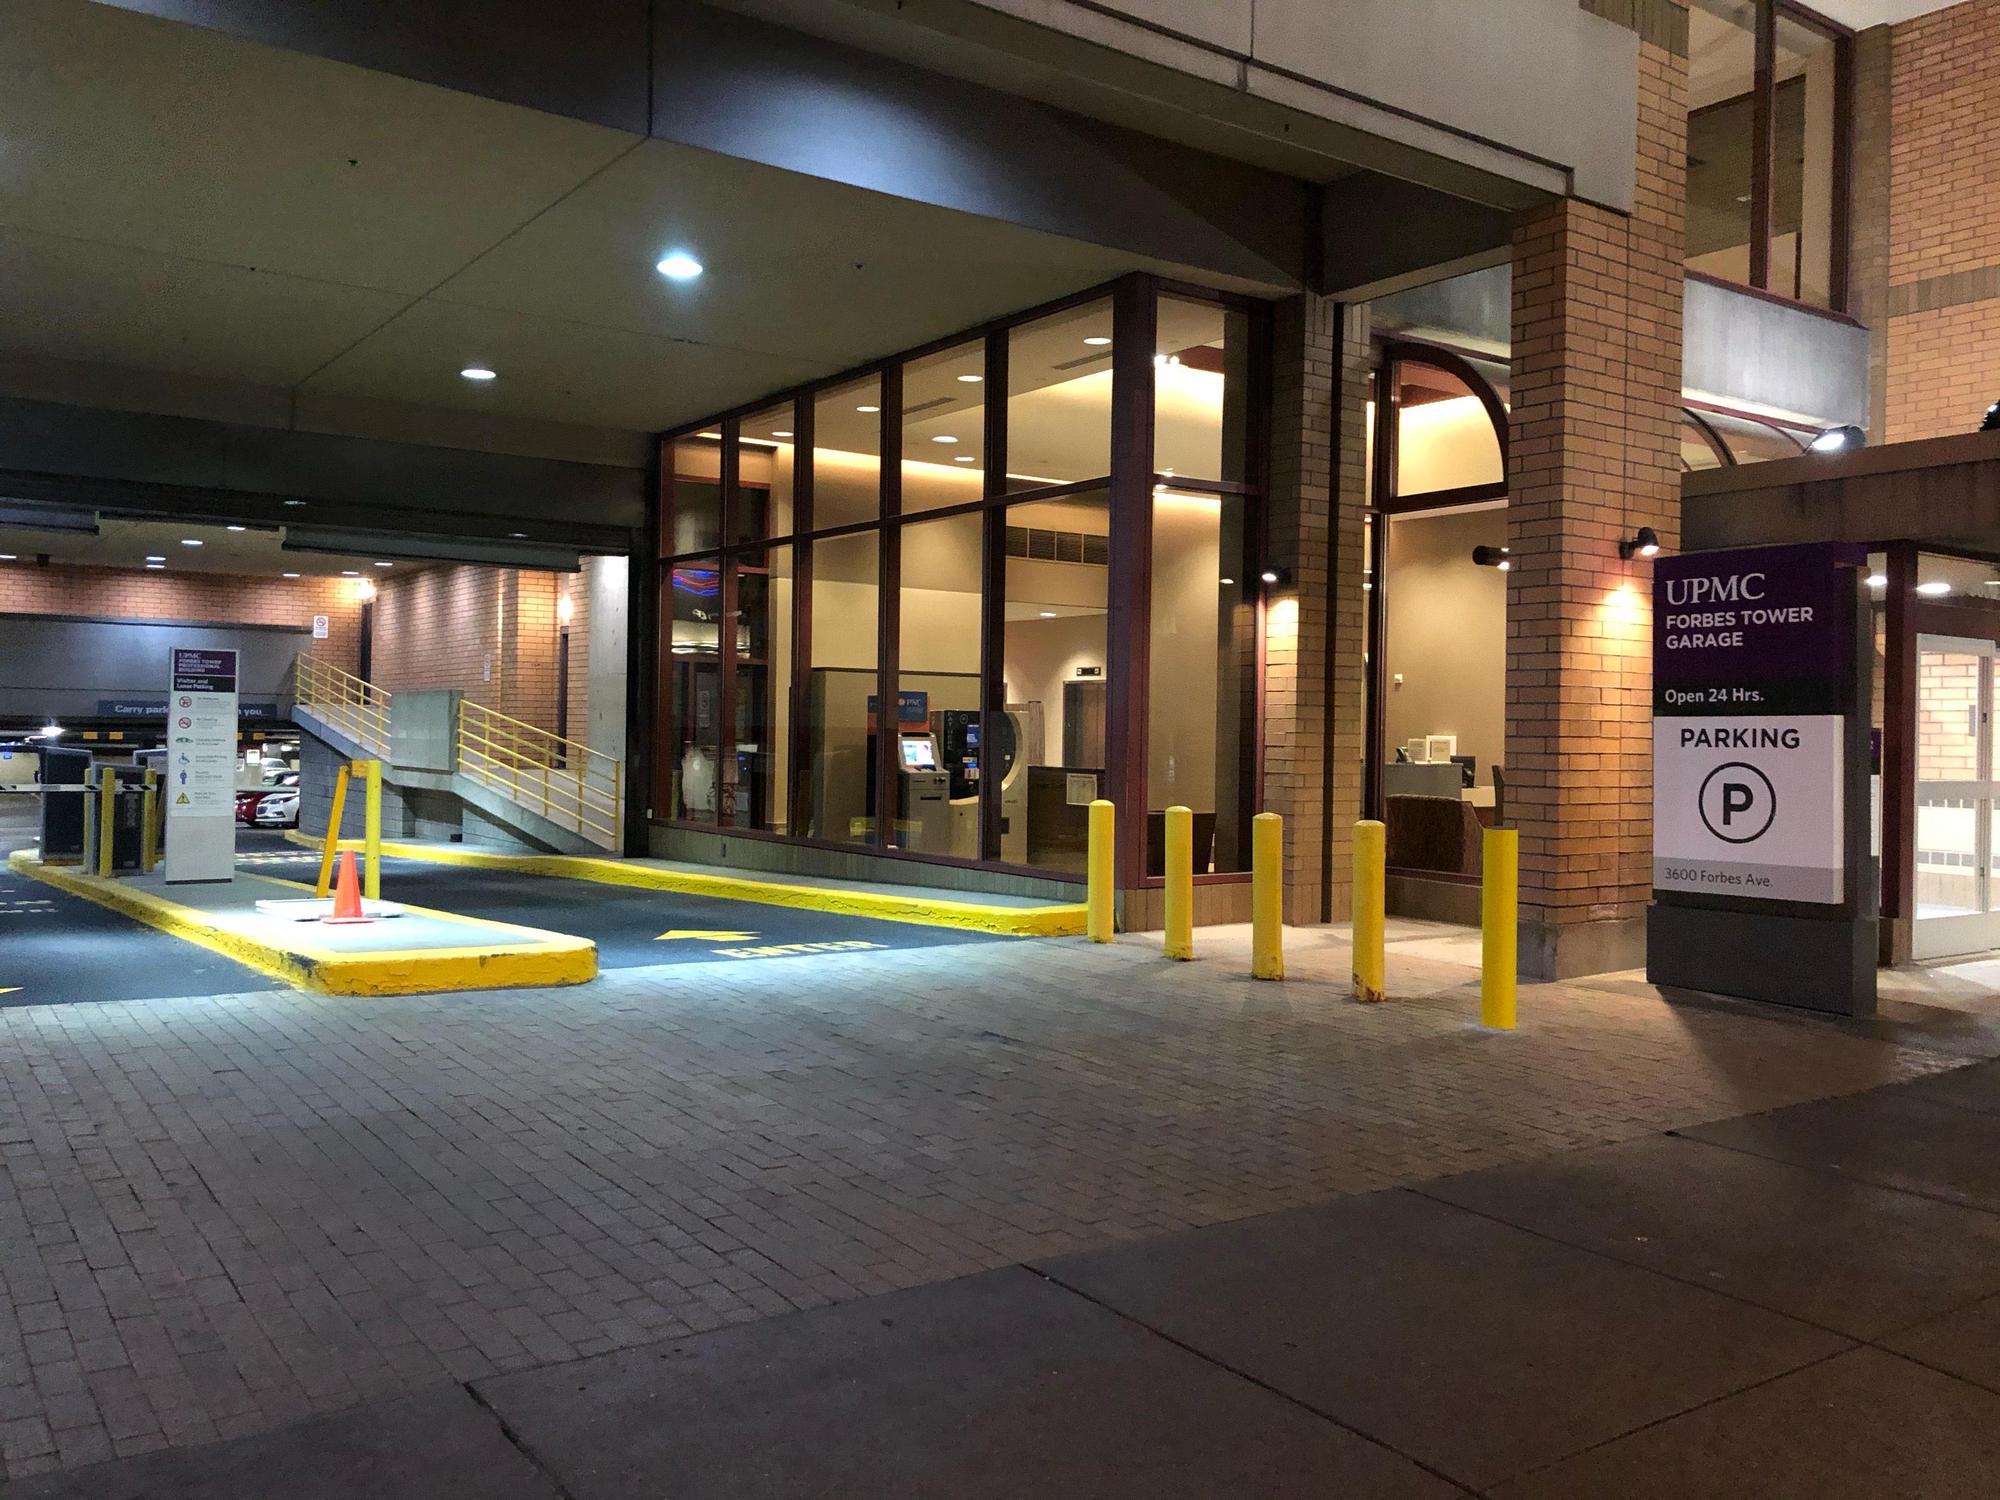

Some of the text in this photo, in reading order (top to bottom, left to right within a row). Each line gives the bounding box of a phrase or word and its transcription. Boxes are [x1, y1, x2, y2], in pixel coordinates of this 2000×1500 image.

[1665, 573, 1765, 605] UPMC
[1665, 606, 1814, 630] FORBES TOWER
[1665, 631, 1744, 650] GARAGE
[1664, 687, 1765, 706] Open 24 Hrs.
[114, 704, 144, 715] Carry
[243, 708, 262, 717] you
[1680, 728, 1801, 750] PARKING
[1722, 783, 1754, 826] P
[1664, 867, 1774, 888] 3600 Forbes Ave.
